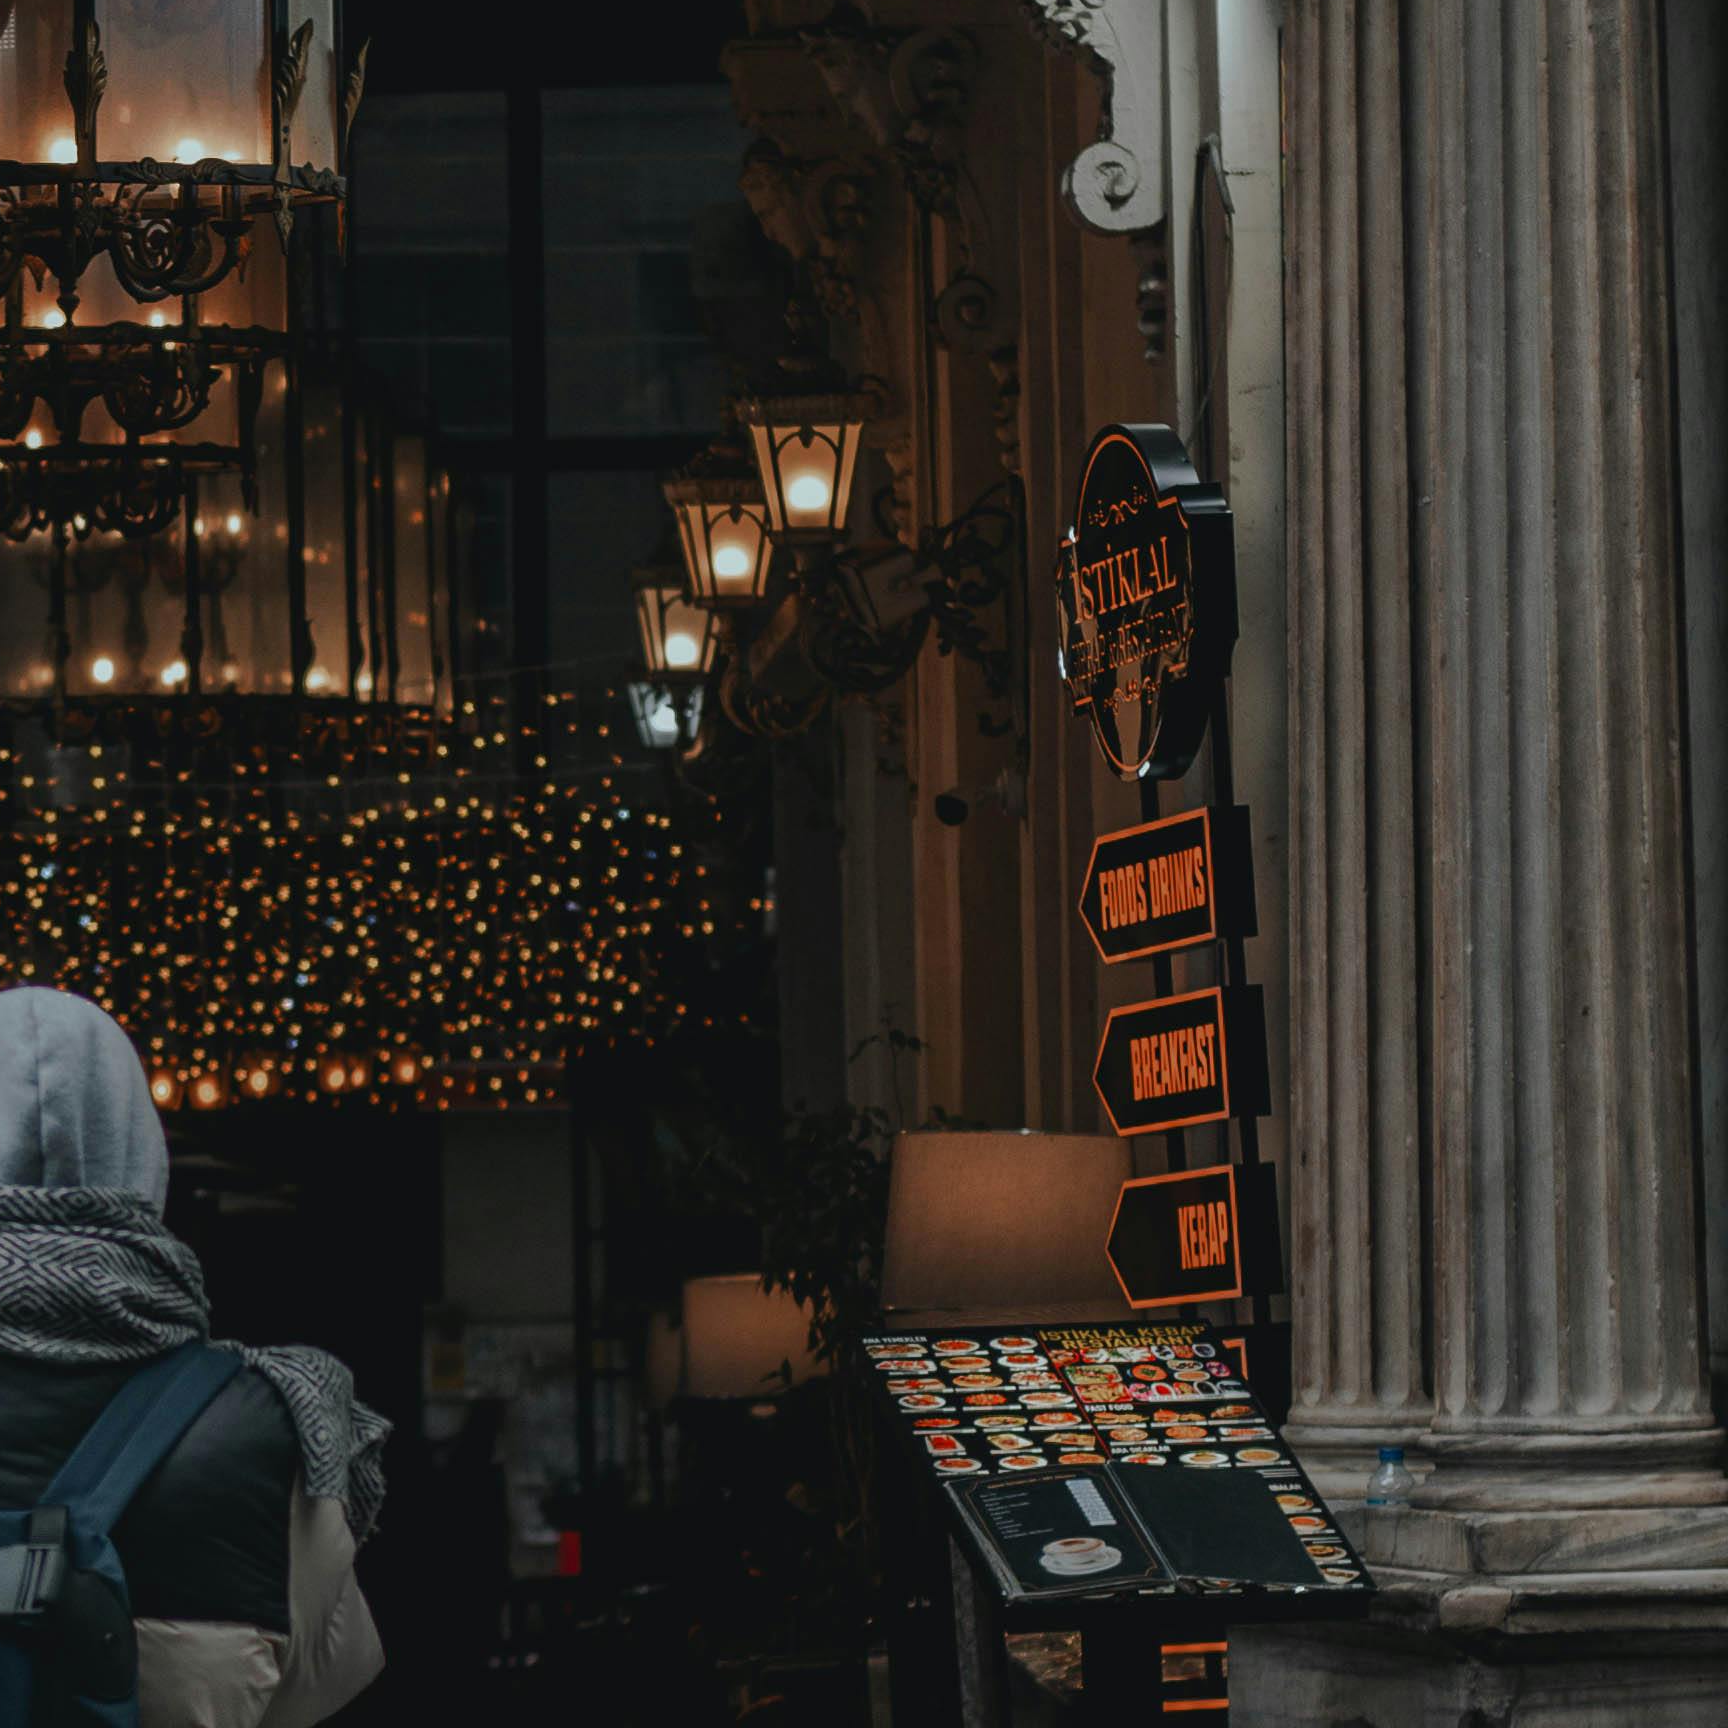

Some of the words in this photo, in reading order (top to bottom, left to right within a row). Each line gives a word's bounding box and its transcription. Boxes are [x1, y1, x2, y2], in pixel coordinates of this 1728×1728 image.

[1098, 861, 1148, 931] FOODS
[1148, 845, 1207, 920] DRINKS
[1130, 1022, 1217, 1102] BREAKFAST
[1177, 1201, 1230, 1271] KEBAP
[1061, 1335, 1195, 1350] RESTAURANT
[1137, 1325, 1206, 1338] KEBAP
